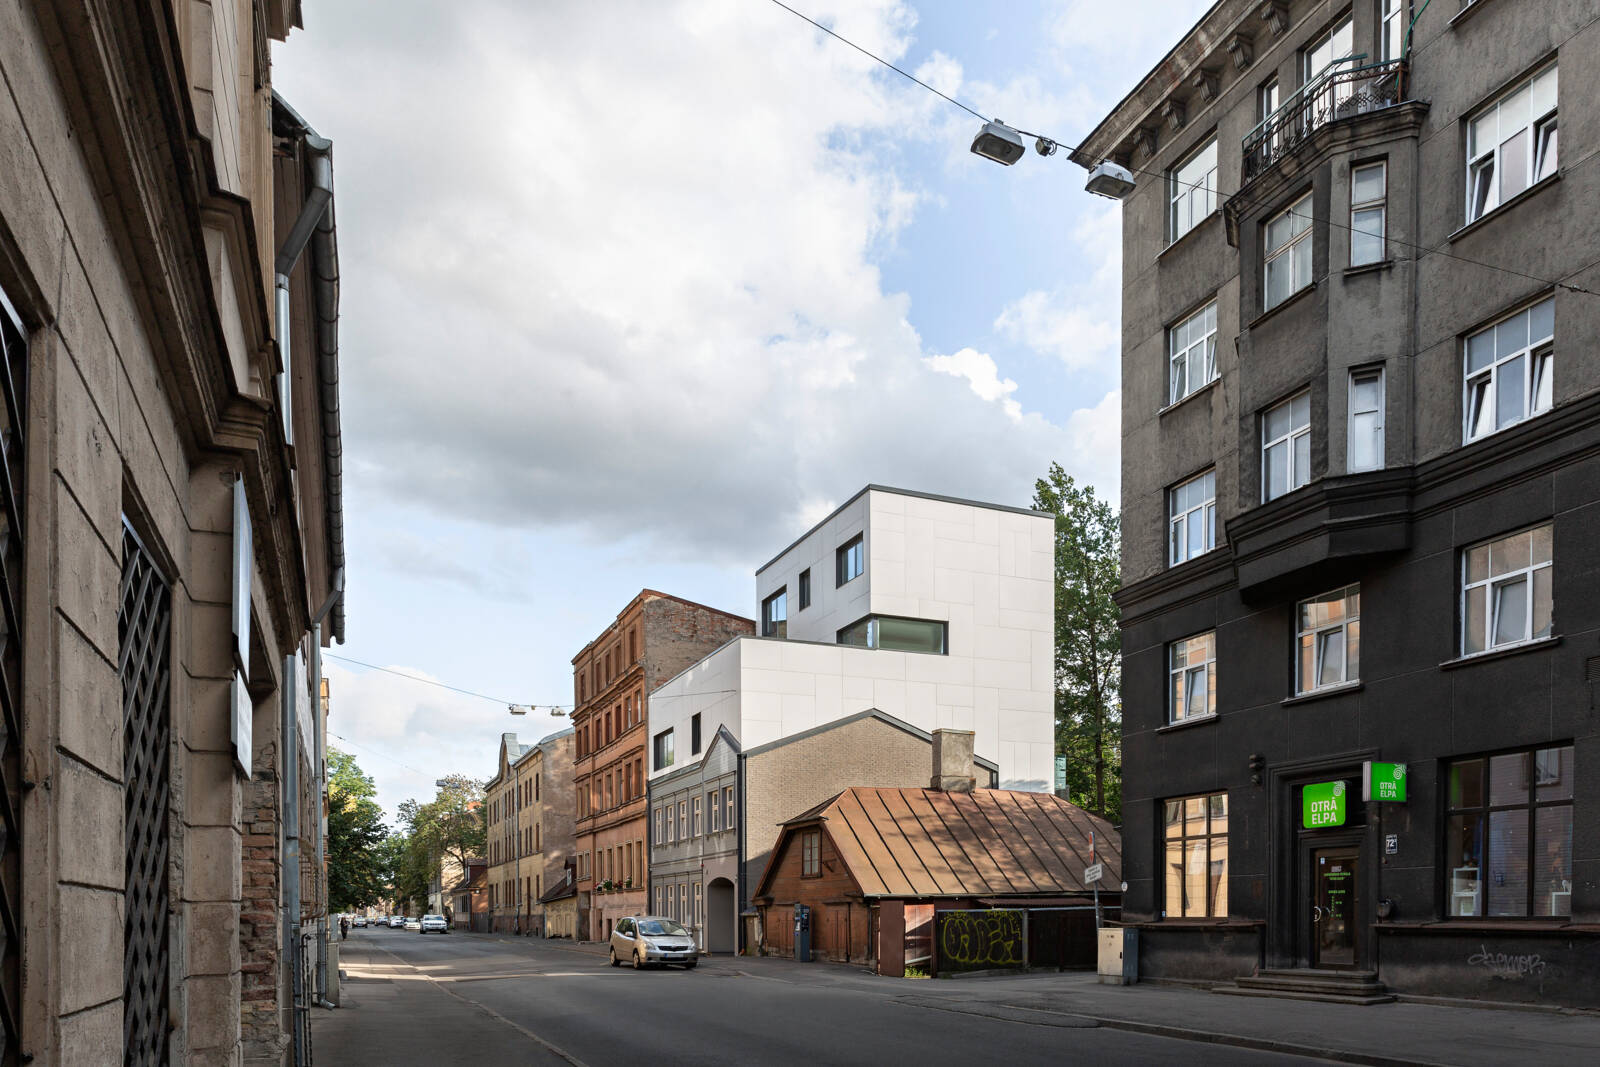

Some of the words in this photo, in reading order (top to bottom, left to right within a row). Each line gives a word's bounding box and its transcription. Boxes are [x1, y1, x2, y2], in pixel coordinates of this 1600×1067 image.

[1380, 781, 1397, 790] OTRĀ
[1380, 790, 1397, 798] ELPA
[1311, 797, 1337, 812] OTRĀ
[1312, 812, 1337, 824] ELPA
